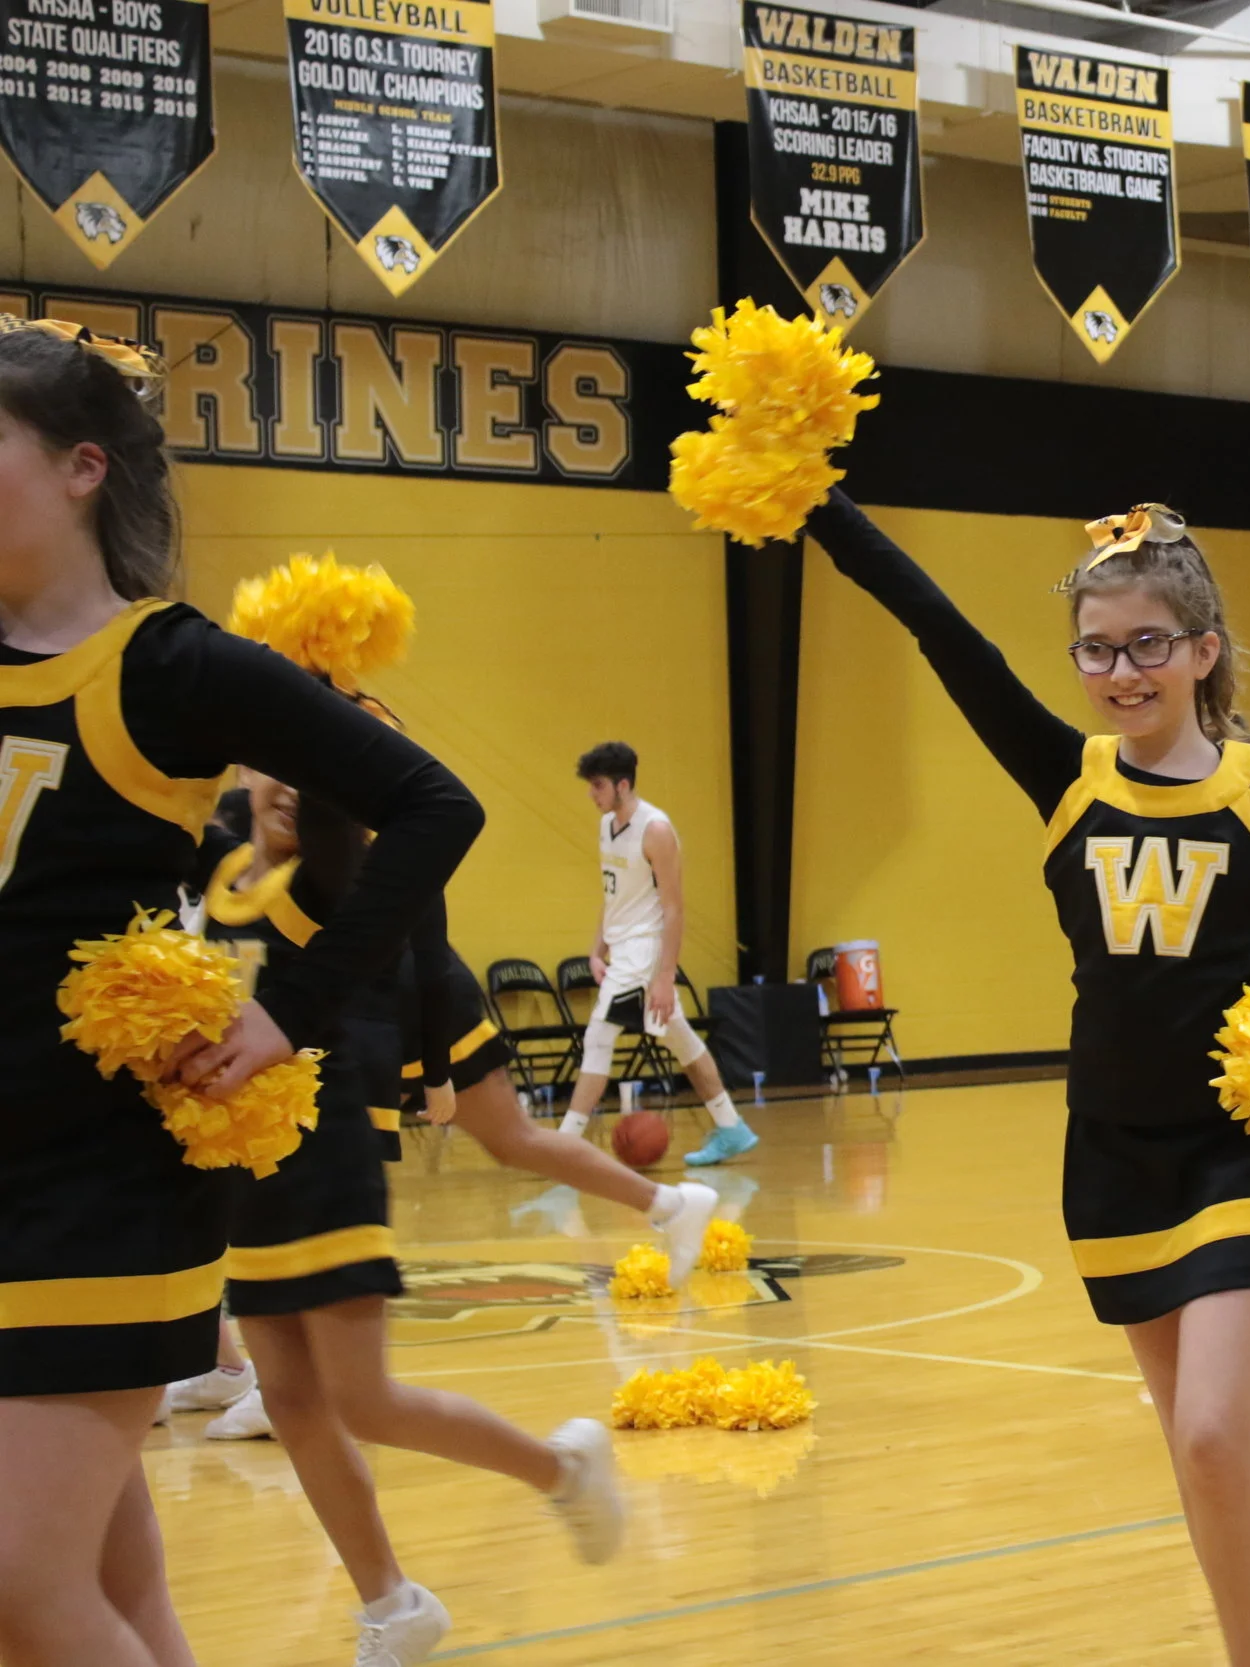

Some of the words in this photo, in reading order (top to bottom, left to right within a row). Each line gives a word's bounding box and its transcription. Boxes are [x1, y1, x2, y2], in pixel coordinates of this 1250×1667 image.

[112, 0, 163, 31] BOYS
[310, 0, 468, 33] VOLLEYBALL
[756, 8, 903, 63] WALDEN
[8, 18, 68, 52] STATE
[71, 26, 181, 68] QUALIFIERS
[304, 28, 352, 59] 2016
[400, 42, 477, 76] TOURNEY
[0, 54, 37, 75] 004
[100, 66, 144, 88] 2009
[153, 75, 197, 95] 2010
[299, 60, 344, 91] GOLD
[347, 67, 380, 96] DIV.
[384, 72, 484, 110] CHAMPIONS
[763, 59, 897, 99] BASKETBALL
[1028, 52, 1158, 104] WALDEN
[47, 84, 92, 106] 2012
[421, 110, 453, 124] TEAM
[769, 97, 821, 130] KHSAA
[831, 106, 897, 137] 2015/16
[1024, 98, 1161, 139] BASKETBRAWL
[773, 127, 836, 158] SCORING
[838, 138, 893, 166] LEADER
[1023, 133, 1080, 164] FACULTY
[1080, 142, 1102, 167] VS.
[1104, 146, 1168, 176] STUDENTS
[811, 162, 837, 182] 32.9
[838, 165, 861, 185] PPG
[1030, 162, 1124, 196] BASKETBRAWL
[1125, 176, 1162, 202] GAME
[800, 187, 870, 222] MIKE
[784, 216, 886, 254] HARRIS
[1084, 836, 1230, 957] W
